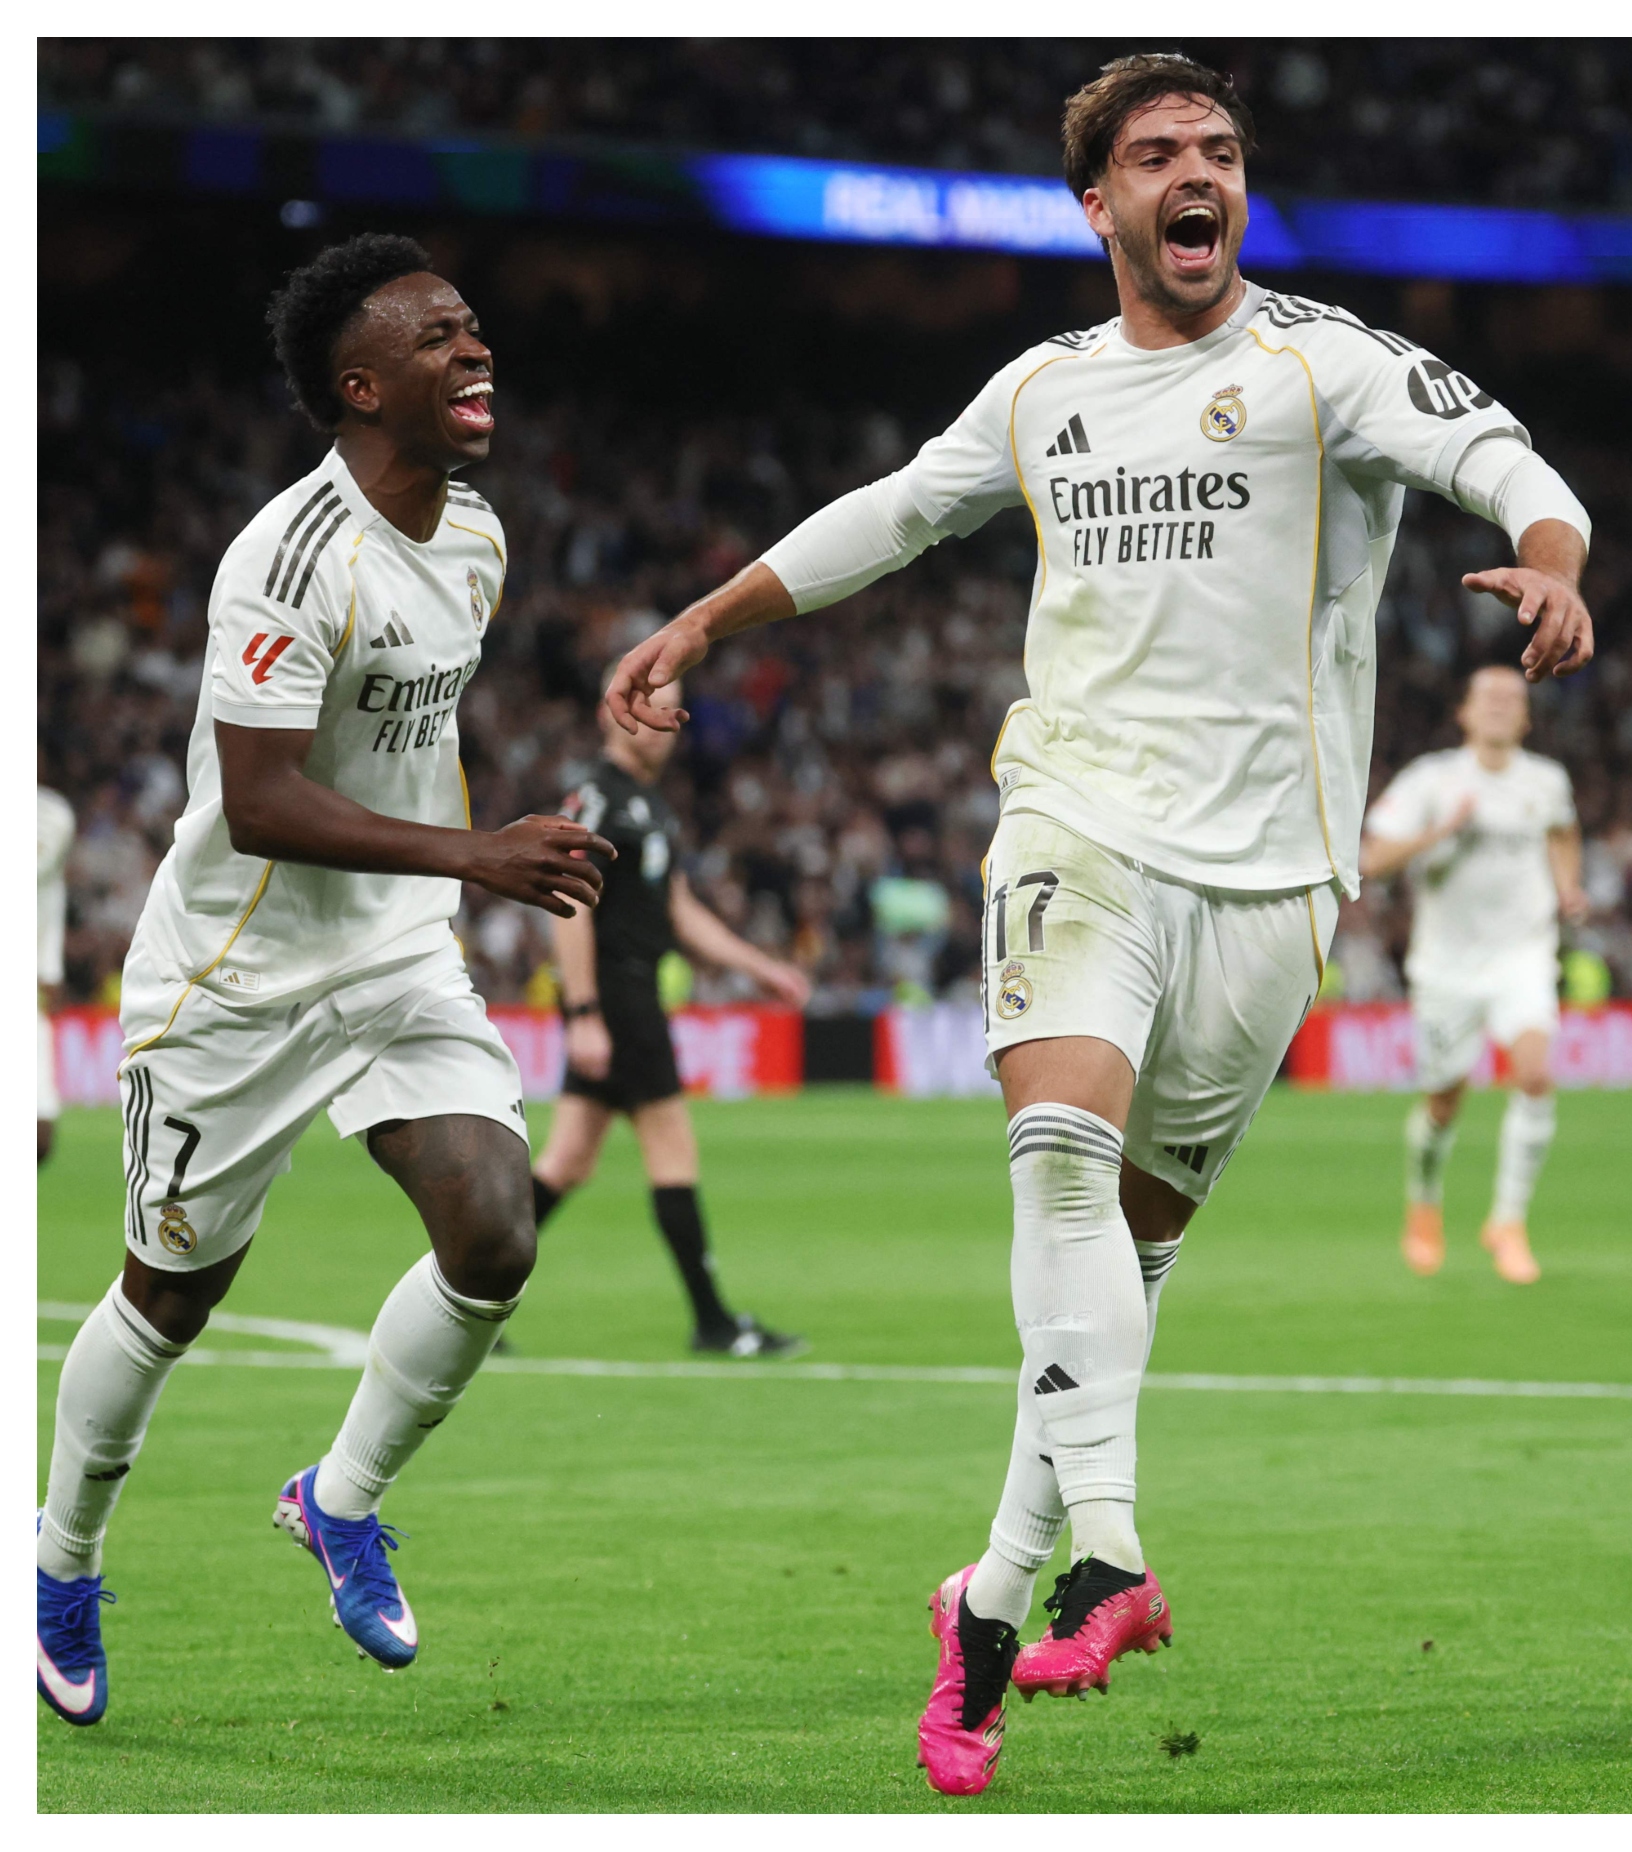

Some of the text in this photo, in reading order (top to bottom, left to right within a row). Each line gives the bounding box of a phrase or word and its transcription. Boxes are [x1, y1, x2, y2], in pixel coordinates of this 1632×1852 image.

[1413, 360, 1482, 414] hp
[1050, 466, 1251, 524] Emirates
[1074, 521, 1215, 567] FLY BETTER
[372, 719, 416, 753] FLY
[992, 870, 1060, 963] 17
[163, 1116, 201, 1198] 7
